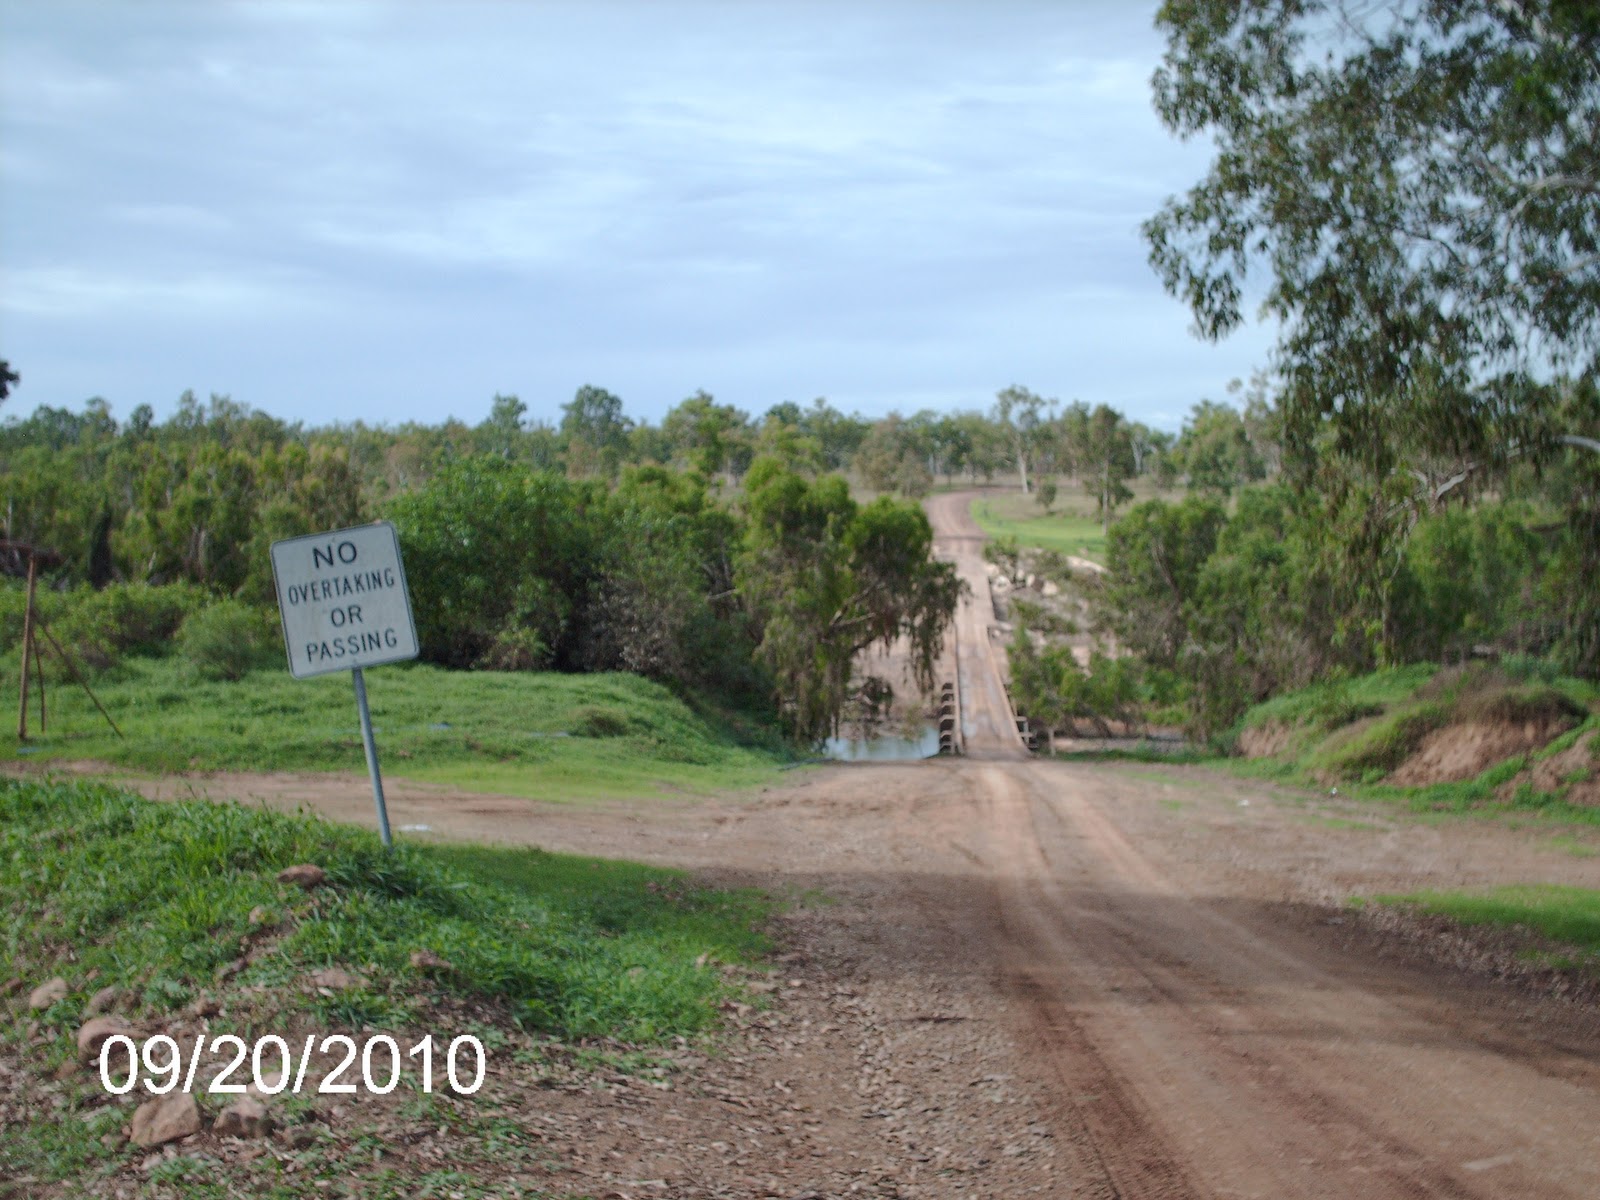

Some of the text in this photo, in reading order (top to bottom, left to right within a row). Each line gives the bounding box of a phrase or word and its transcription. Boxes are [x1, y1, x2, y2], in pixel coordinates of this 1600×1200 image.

[312, 541, 357, 569] NO
[288, 567, 395, 606] OVERTAKING
[330, 604, 363, 628] OR
[306, 627, 397, 663] PASSING
